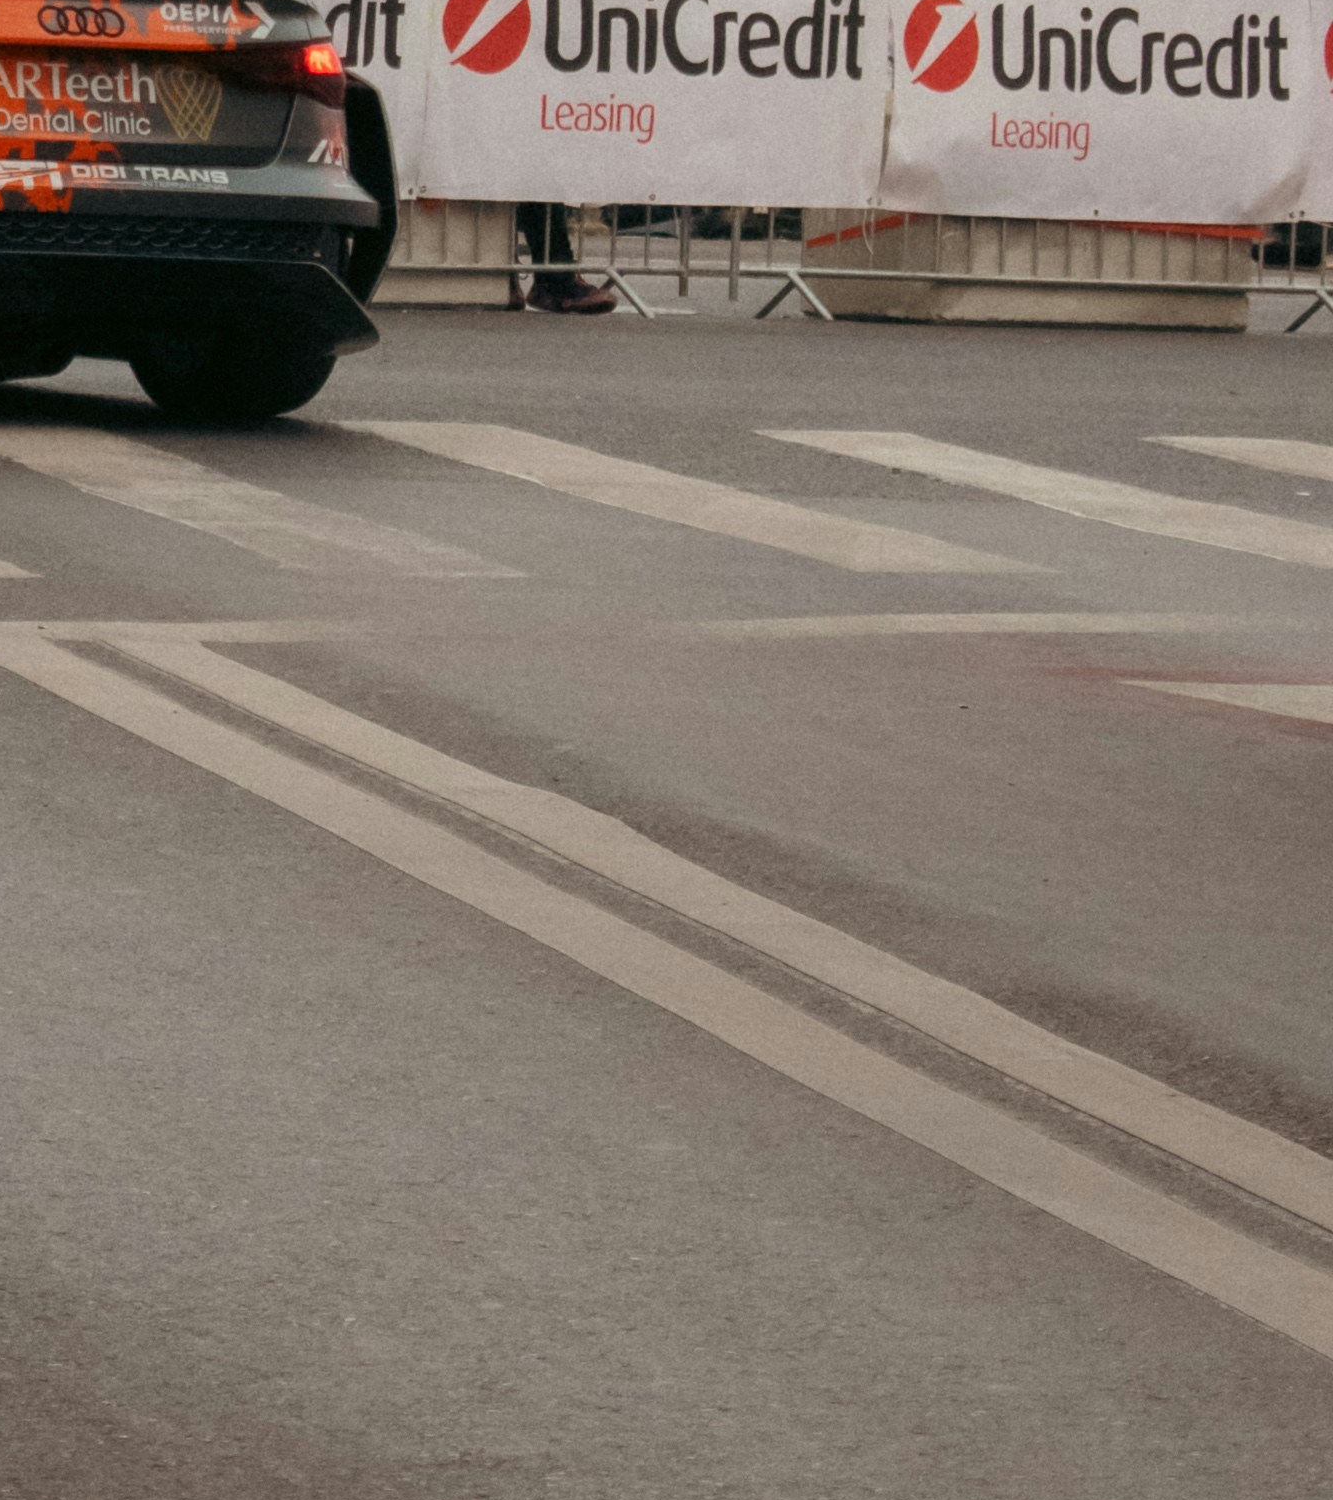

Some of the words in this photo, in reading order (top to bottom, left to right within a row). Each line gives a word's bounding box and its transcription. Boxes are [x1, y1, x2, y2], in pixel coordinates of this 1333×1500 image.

[992, 3, 1290, 102] UniCredit
[82, 109, 152, 136] Clinic
[540, 93, 656, 146] Leasing
[990, 111, 1091, 162] Leasing
[69, 163, 127, 180] DIDI
[134, 166, 230, 185] TRANS
